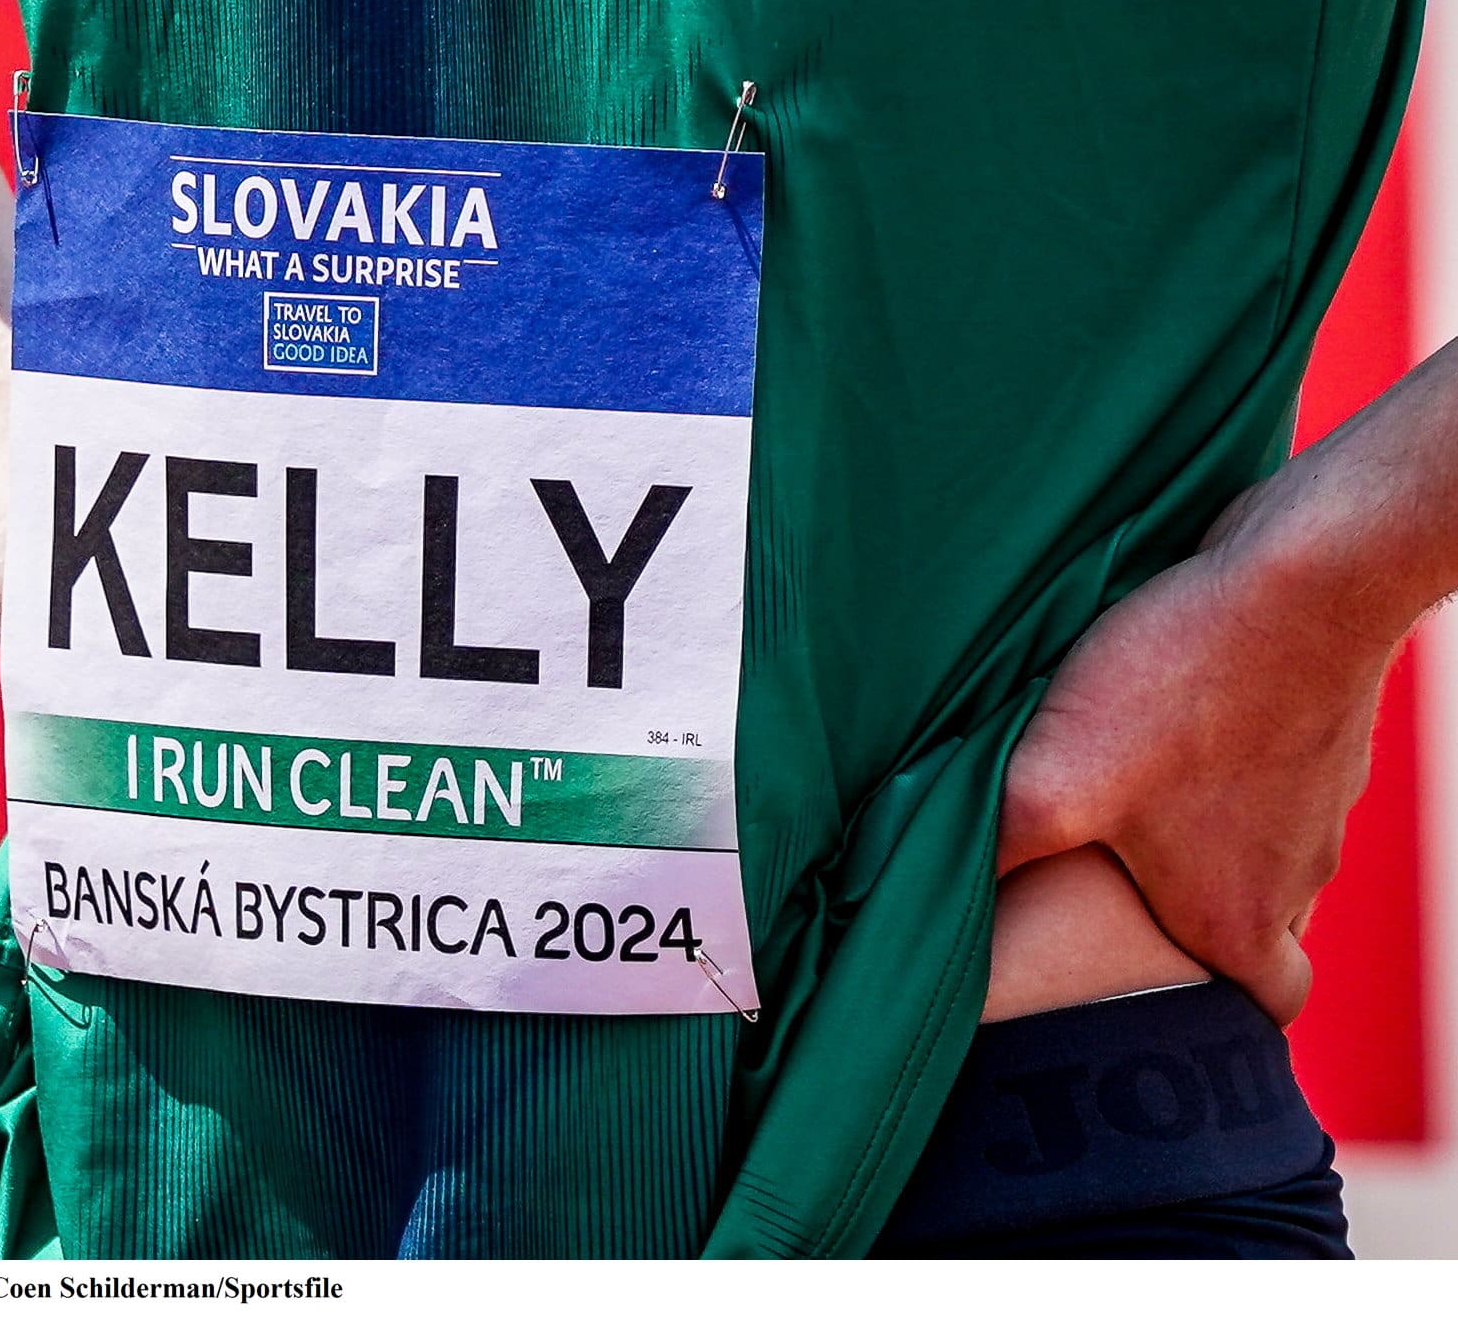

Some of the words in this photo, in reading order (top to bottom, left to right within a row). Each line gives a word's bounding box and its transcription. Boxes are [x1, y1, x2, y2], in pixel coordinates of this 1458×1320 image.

[170, 170, 498, 250] SLOVAKIA
[197, 246, 280, 280] WHAT
[284, 252, 304, 281] A
[312, 254, 461, 289] SURPRISE
[273, 302, 332, 323] TRAVEL
[338, 305, 362, 324] TO
[273, 323, 350, 344] SLOVAKIA
[273, 343, 324, 362] GOOD
[330, 345, 368, 364] IDEA
[47, 443, 694, 690] KELLY
[647, 730, 669, 745] 384
[681, 732, 702, 747] IRL
[127, 734, 138, 803] I
[153, 737, 273, 812] RUN
[43, 859, 222, 937] BANSKÁ
[234, 881, 518, 959] BYSTRICA
[534, 900, 703, 964] 2024
